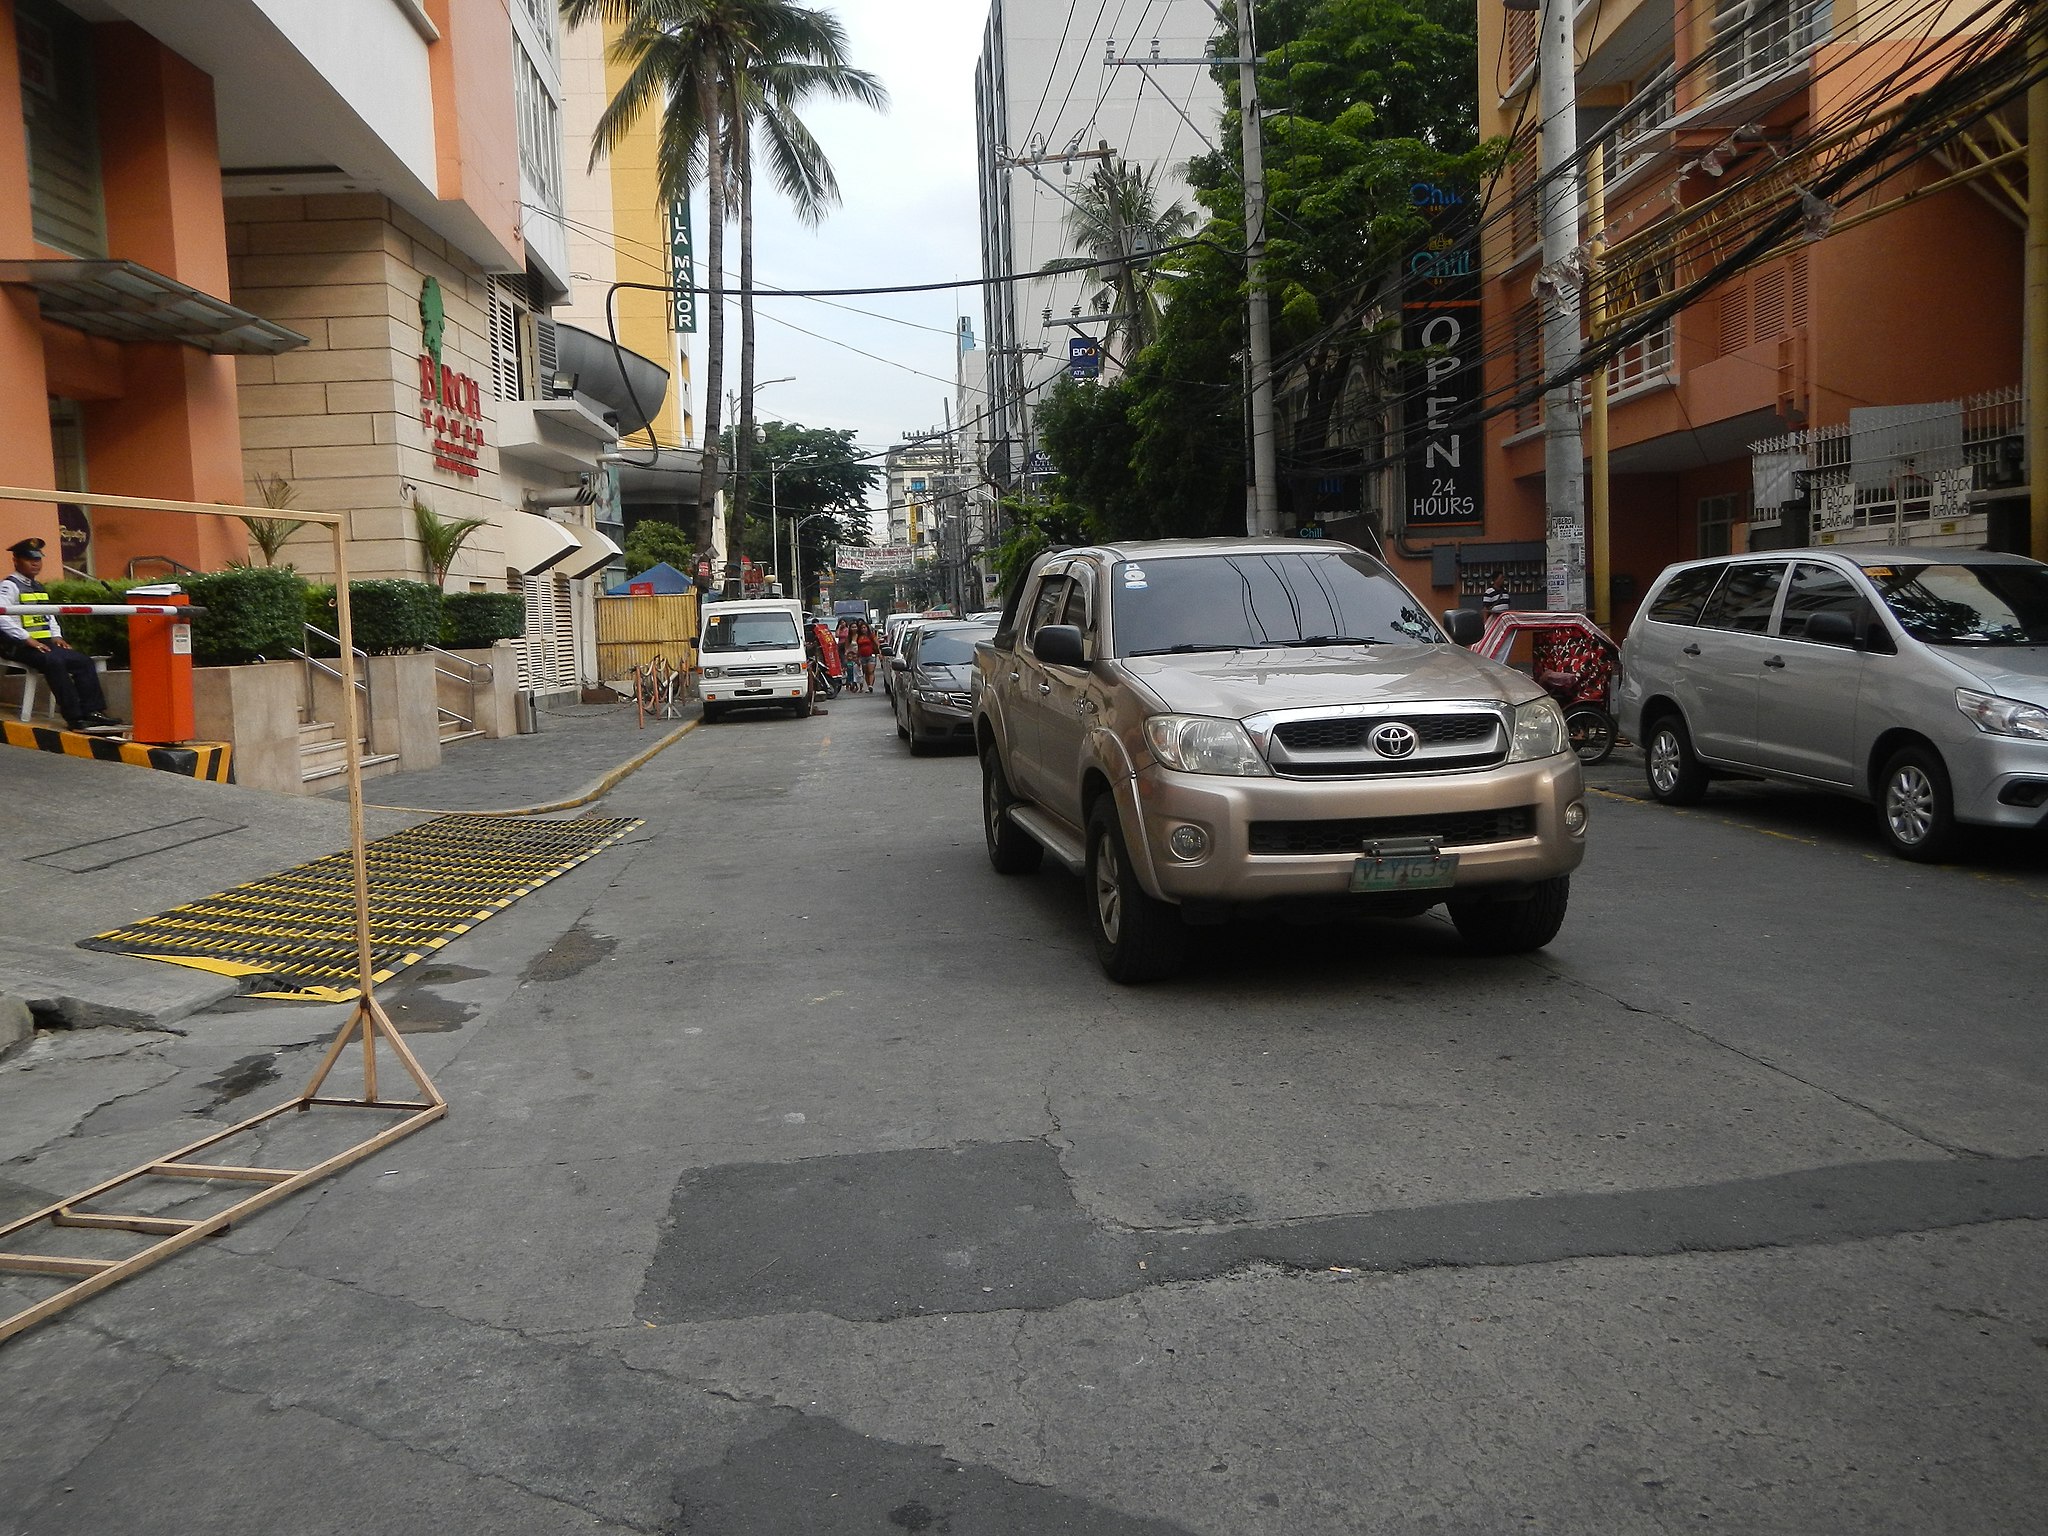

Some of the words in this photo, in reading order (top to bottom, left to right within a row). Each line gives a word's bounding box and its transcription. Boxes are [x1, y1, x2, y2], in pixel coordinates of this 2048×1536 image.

[674, 255, 693, 328] MANOR
[419, 354, 483, 421] BIRCH
[1421, 316, 1461, 468] OPEN
[422, 408, 485, 446] TOWER
[1432, 478, 1456, 496] 24
[1940, 478, 1970, 492] BLOCK
[1413, 496, 1475, 516] HOURS
[1827, 494, 1853, 509] BLOCK
[1940, 491, 1958, 505] THE
[1300, 527, 1323, 538] Chill
